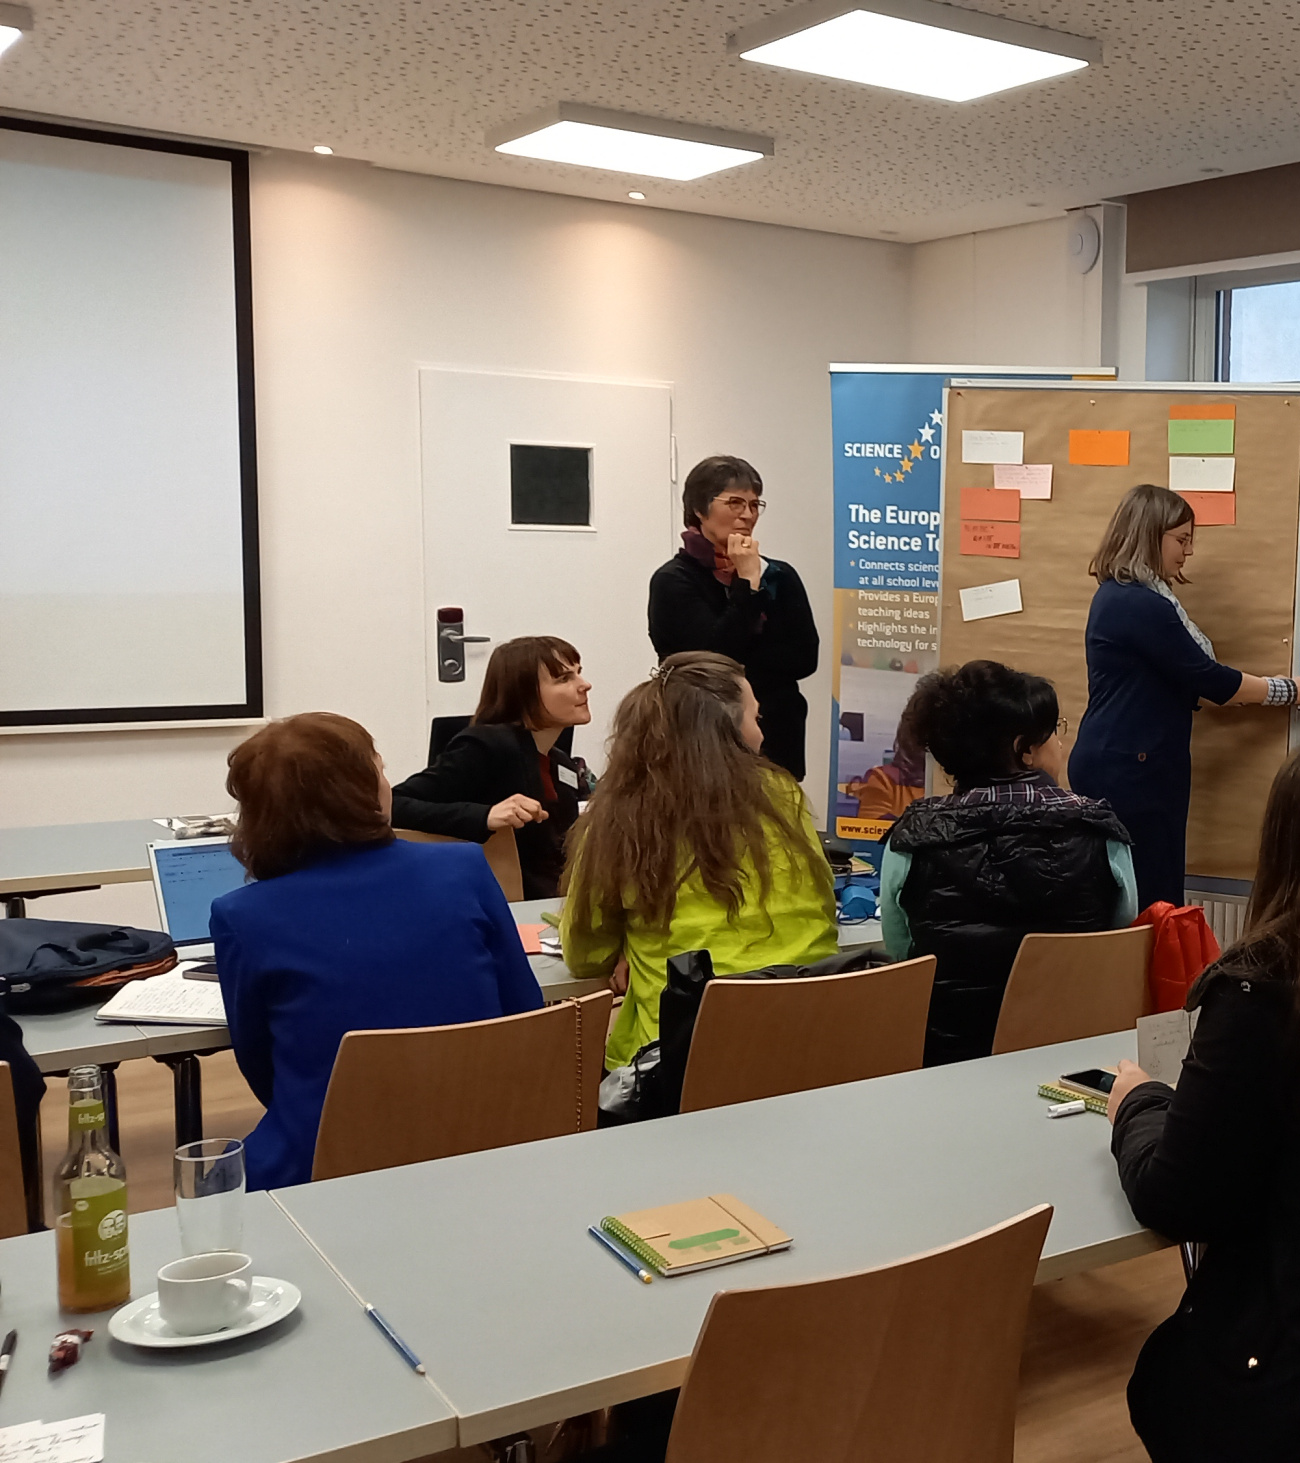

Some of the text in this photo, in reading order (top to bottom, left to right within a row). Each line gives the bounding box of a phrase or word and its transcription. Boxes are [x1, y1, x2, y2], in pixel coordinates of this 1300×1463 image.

[844, 443, 902, 458] SCIENCE
[848, 504, 940, 531] The Europ
[848, 530, 922, 551] Science
[859, 559, 905, 571] Connects
[858, 576, 869, 585] at
[871, 575, 884, 586] all
[886, 576, 919, 588] school
[858, 590, 900, 602] Provides
[903, 594, 910, 602] a
[858, 607, 930, 621] teaching ideas
[857, 621, 907, 636] Highlights
[910, 624, 927, 635] the
[857, 638, 912, 653] technology
[915, 639, 929, 650] for
